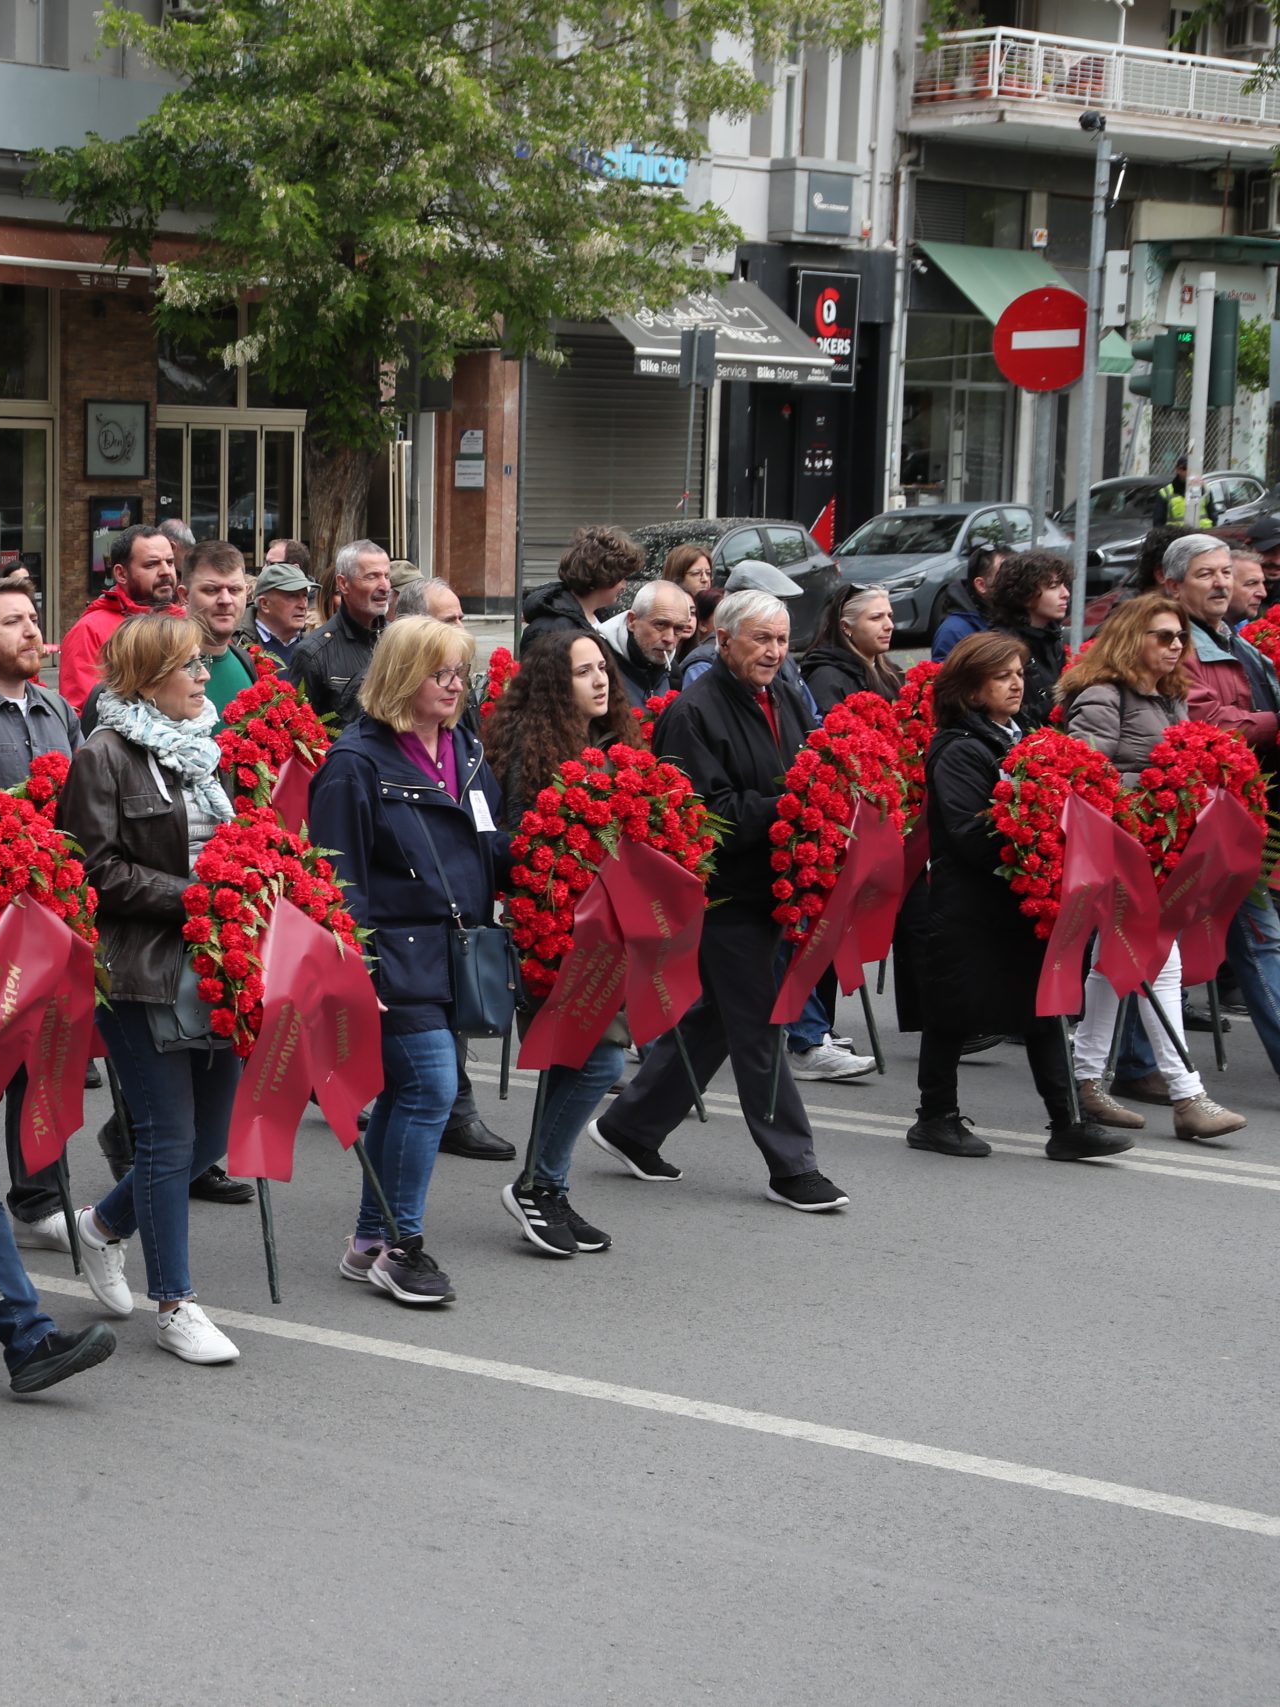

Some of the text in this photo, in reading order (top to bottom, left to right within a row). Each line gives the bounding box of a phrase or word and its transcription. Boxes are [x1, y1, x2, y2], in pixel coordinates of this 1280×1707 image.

[640, 360, 660, 373] Bike
[717, 365, 747, 378] Service
[757, 366, 799, 380] Bike Store
